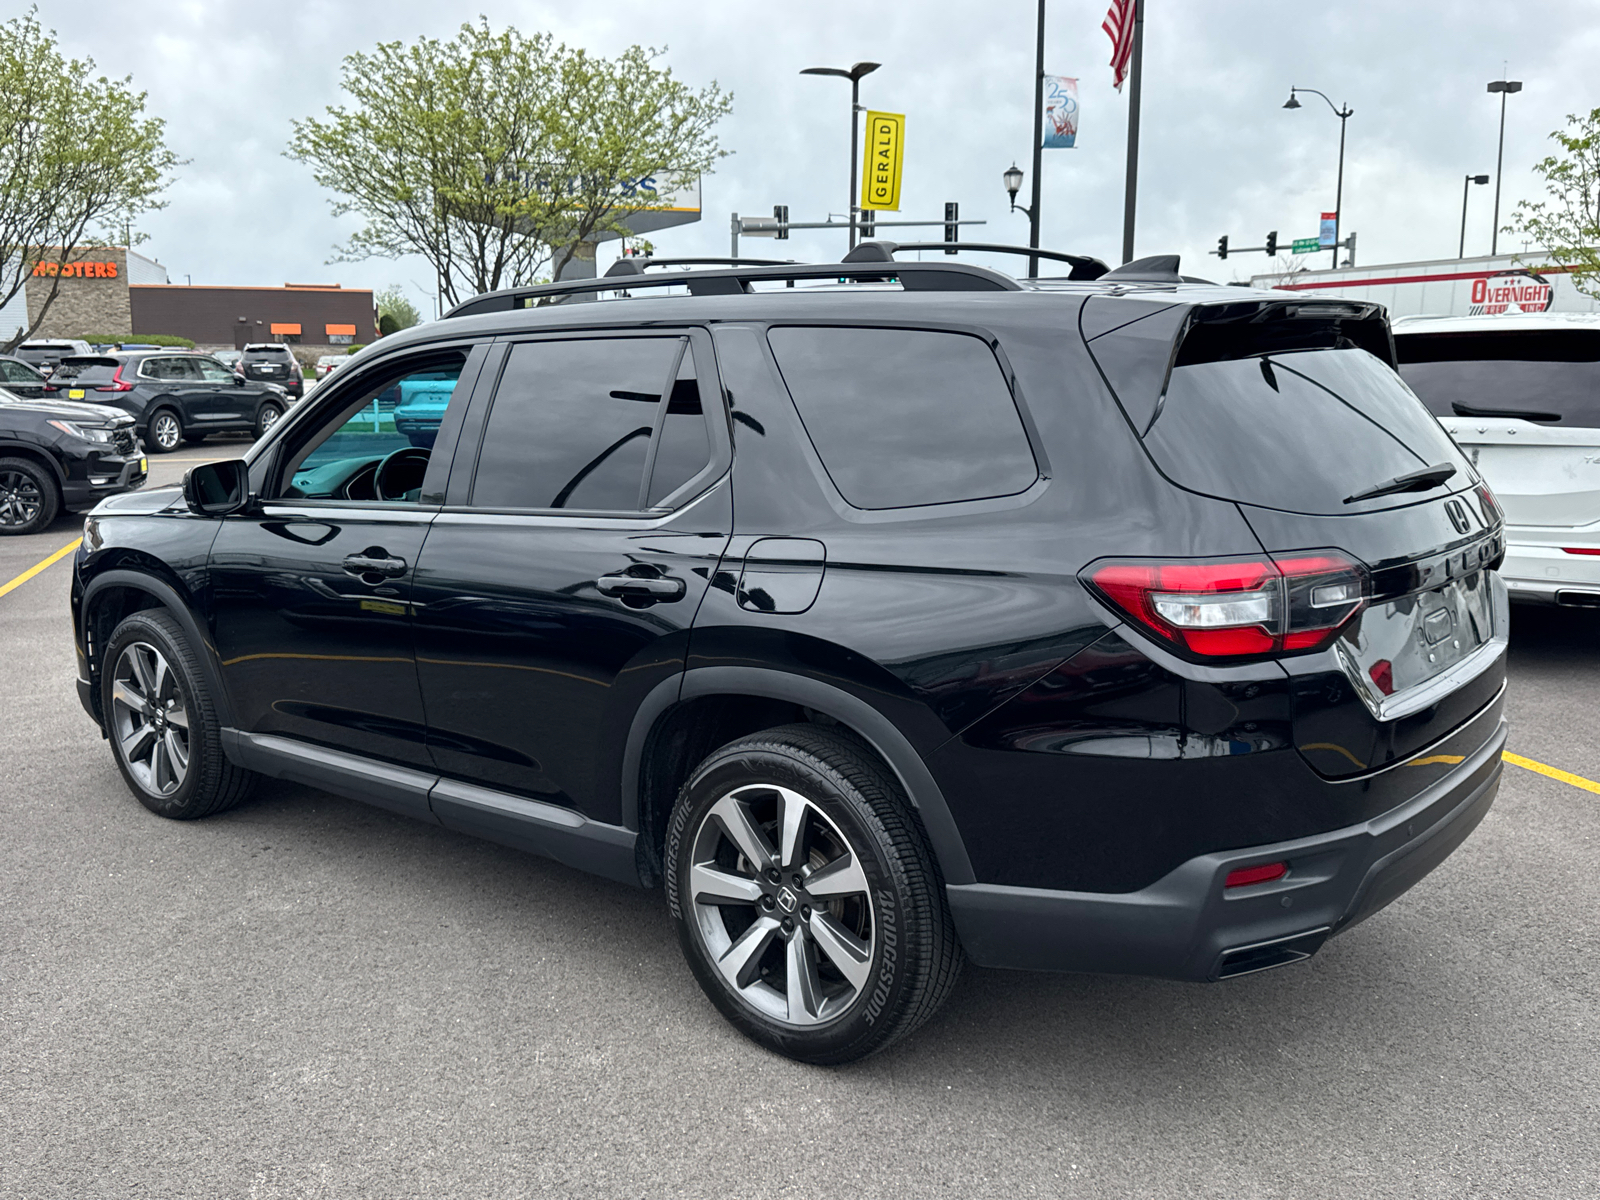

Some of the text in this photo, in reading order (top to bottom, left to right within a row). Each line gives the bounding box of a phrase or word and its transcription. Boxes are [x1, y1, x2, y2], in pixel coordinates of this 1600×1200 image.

[1048, 82, 1077, 114] 250
[875, 125, 891, 197] GERALD
[32, 261, 117, 278] HOOTERS
[1472, 279, 1550, 304] OVERNIGHT
[1419, 534, 1503, 585] PILOT
[667, 796, 694, 920] BRIDGESTONE
[861, 889, 897, 1027] BRIDGESTONE
